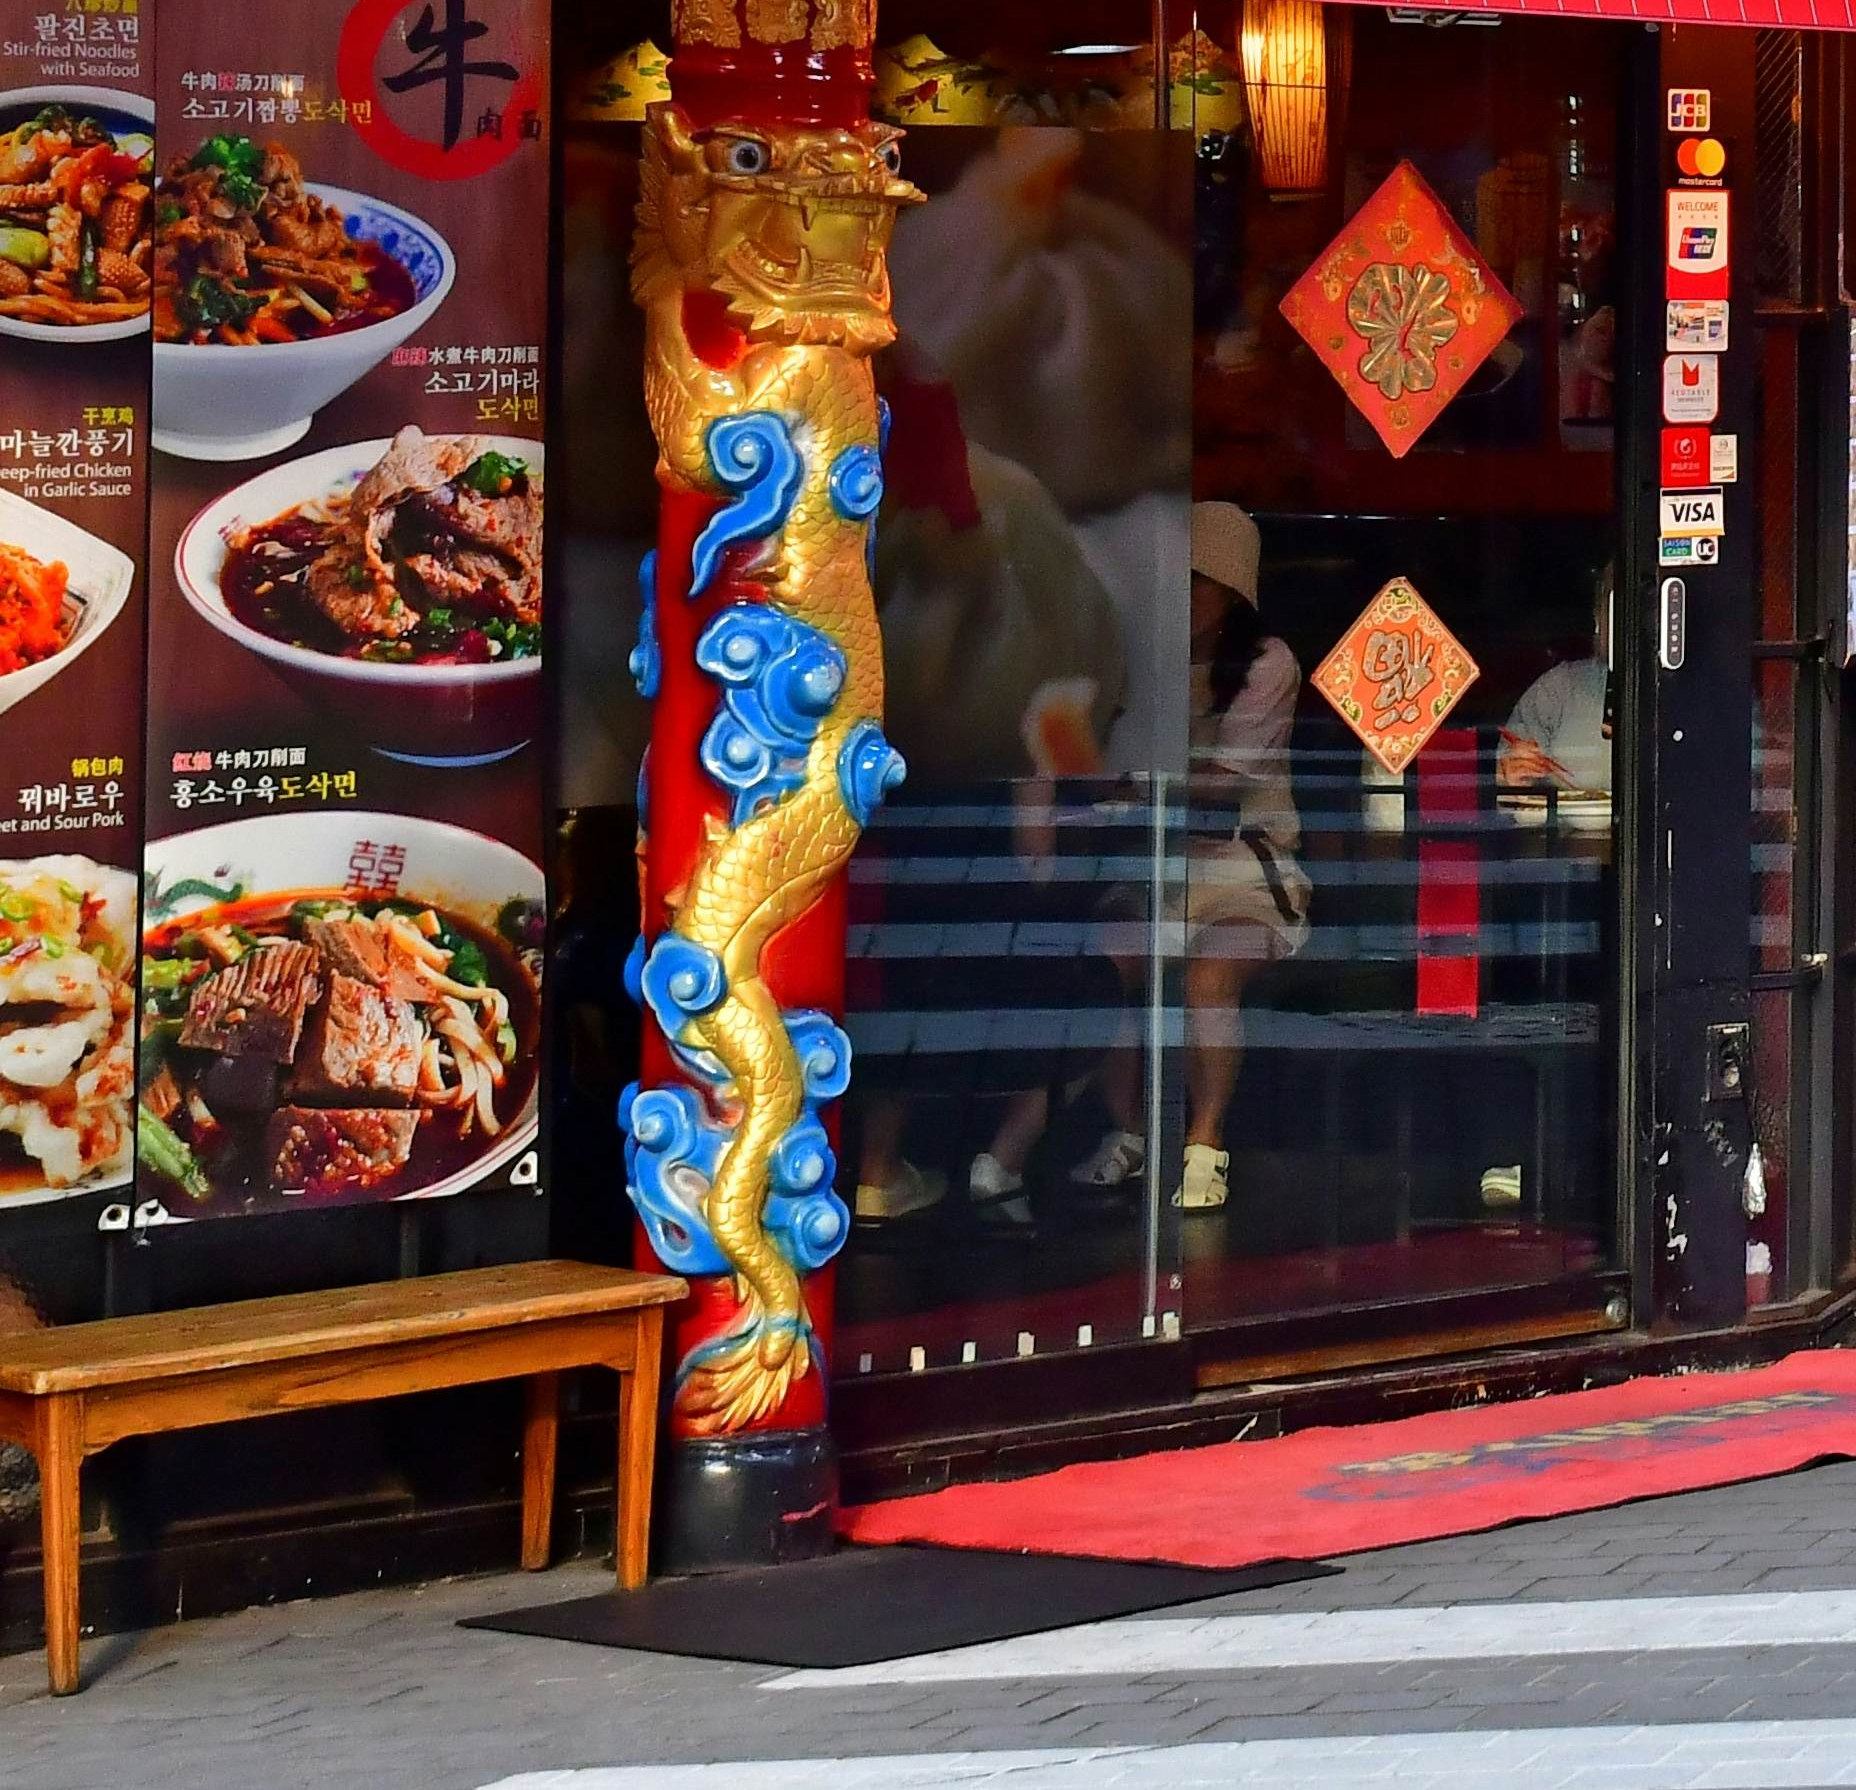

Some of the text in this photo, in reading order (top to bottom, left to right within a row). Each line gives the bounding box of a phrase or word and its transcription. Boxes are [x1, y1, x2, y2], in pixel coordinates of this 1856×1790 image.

[34, 12, 140, 43] 팔진초면
[3, 41, 137, 60] Stir-fried Noodles
[40, 60, 140, 78] with Seafood
[1670, 103, 1707, 118] JCB
[1678, 177, 1723, 187] mastercard
[1677, 201, 1719, 212] WELCOME
[424, 368, 540, 395] 소고기마라
[475, 394, 539, 422] 도삭면
[0, 428, 134, 459] 마늘깐풍기
[0, 462, 132, 483] eep-fried Chicken
[24, 481, 132, 498] in Garlic Sauce
[1669, 502, 1716, 523] VISA
[169, 770, 358, 810] 홍소우육도삭면
[20, 810, 125, 832] and Sour Pork
